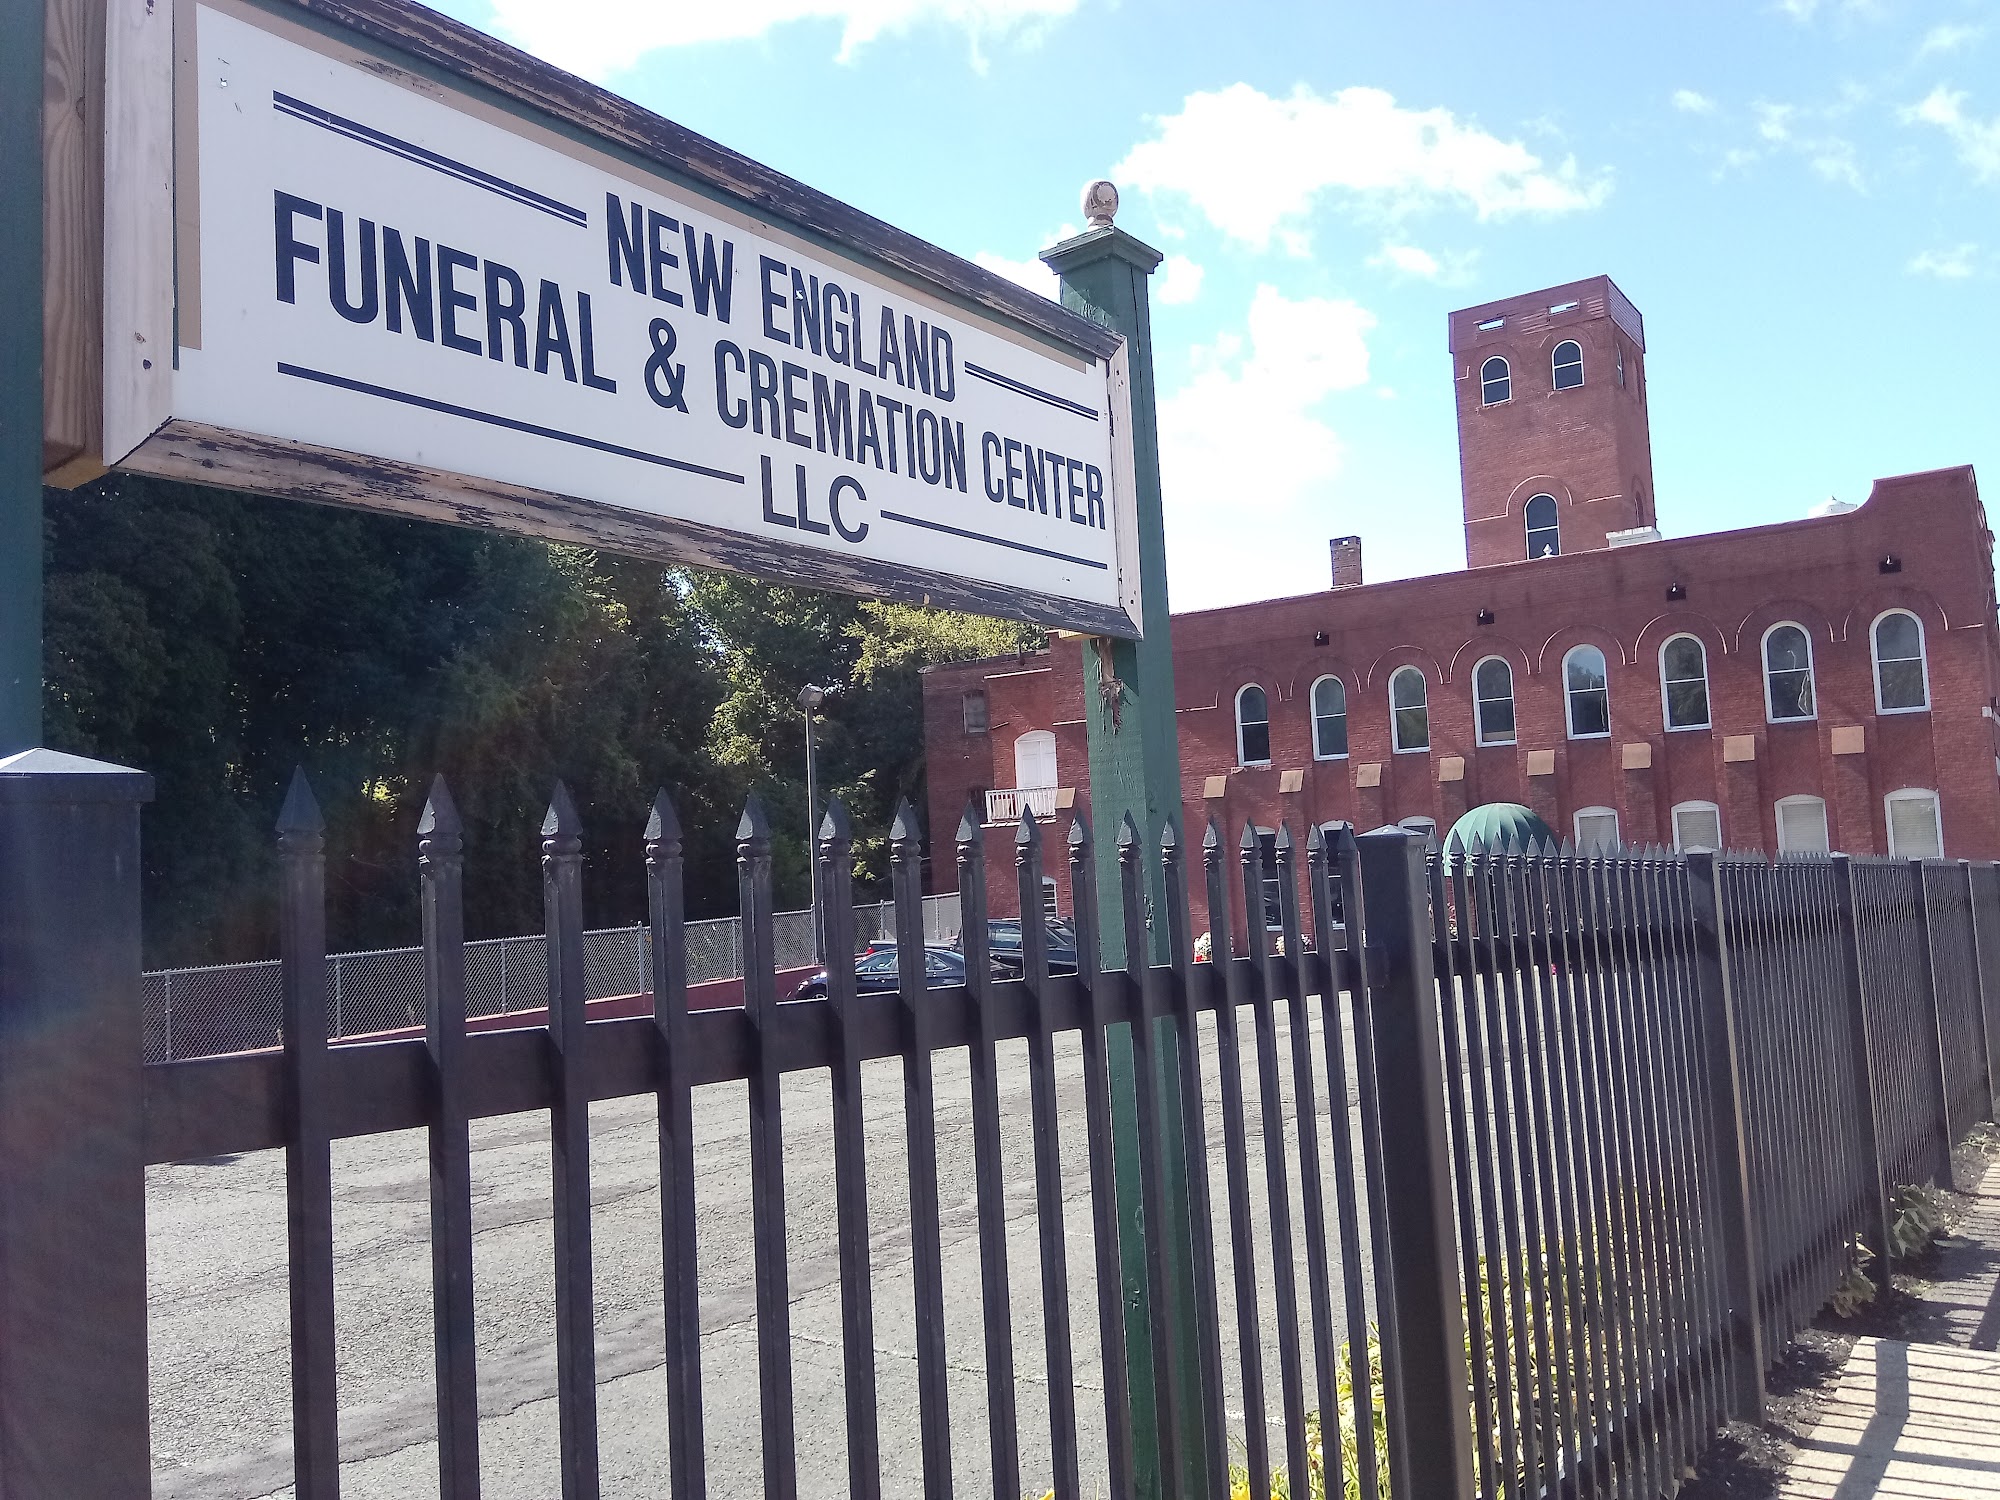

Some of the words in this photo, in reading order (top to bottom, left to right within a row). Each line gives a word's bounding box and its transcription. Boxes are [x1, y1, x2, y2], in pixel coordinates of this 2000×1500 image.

[273, 188, 618, 395] FUNERAL
[643, 317, 690, 415] &
[714, 339, 968, 494] CREMATION
[981, 431, 1107, 531] CENTER
[606, 192, 734, 325] NEW
[759, 253, 956, 403] ENGLAND
[760, 454, 870, 544] LLC
